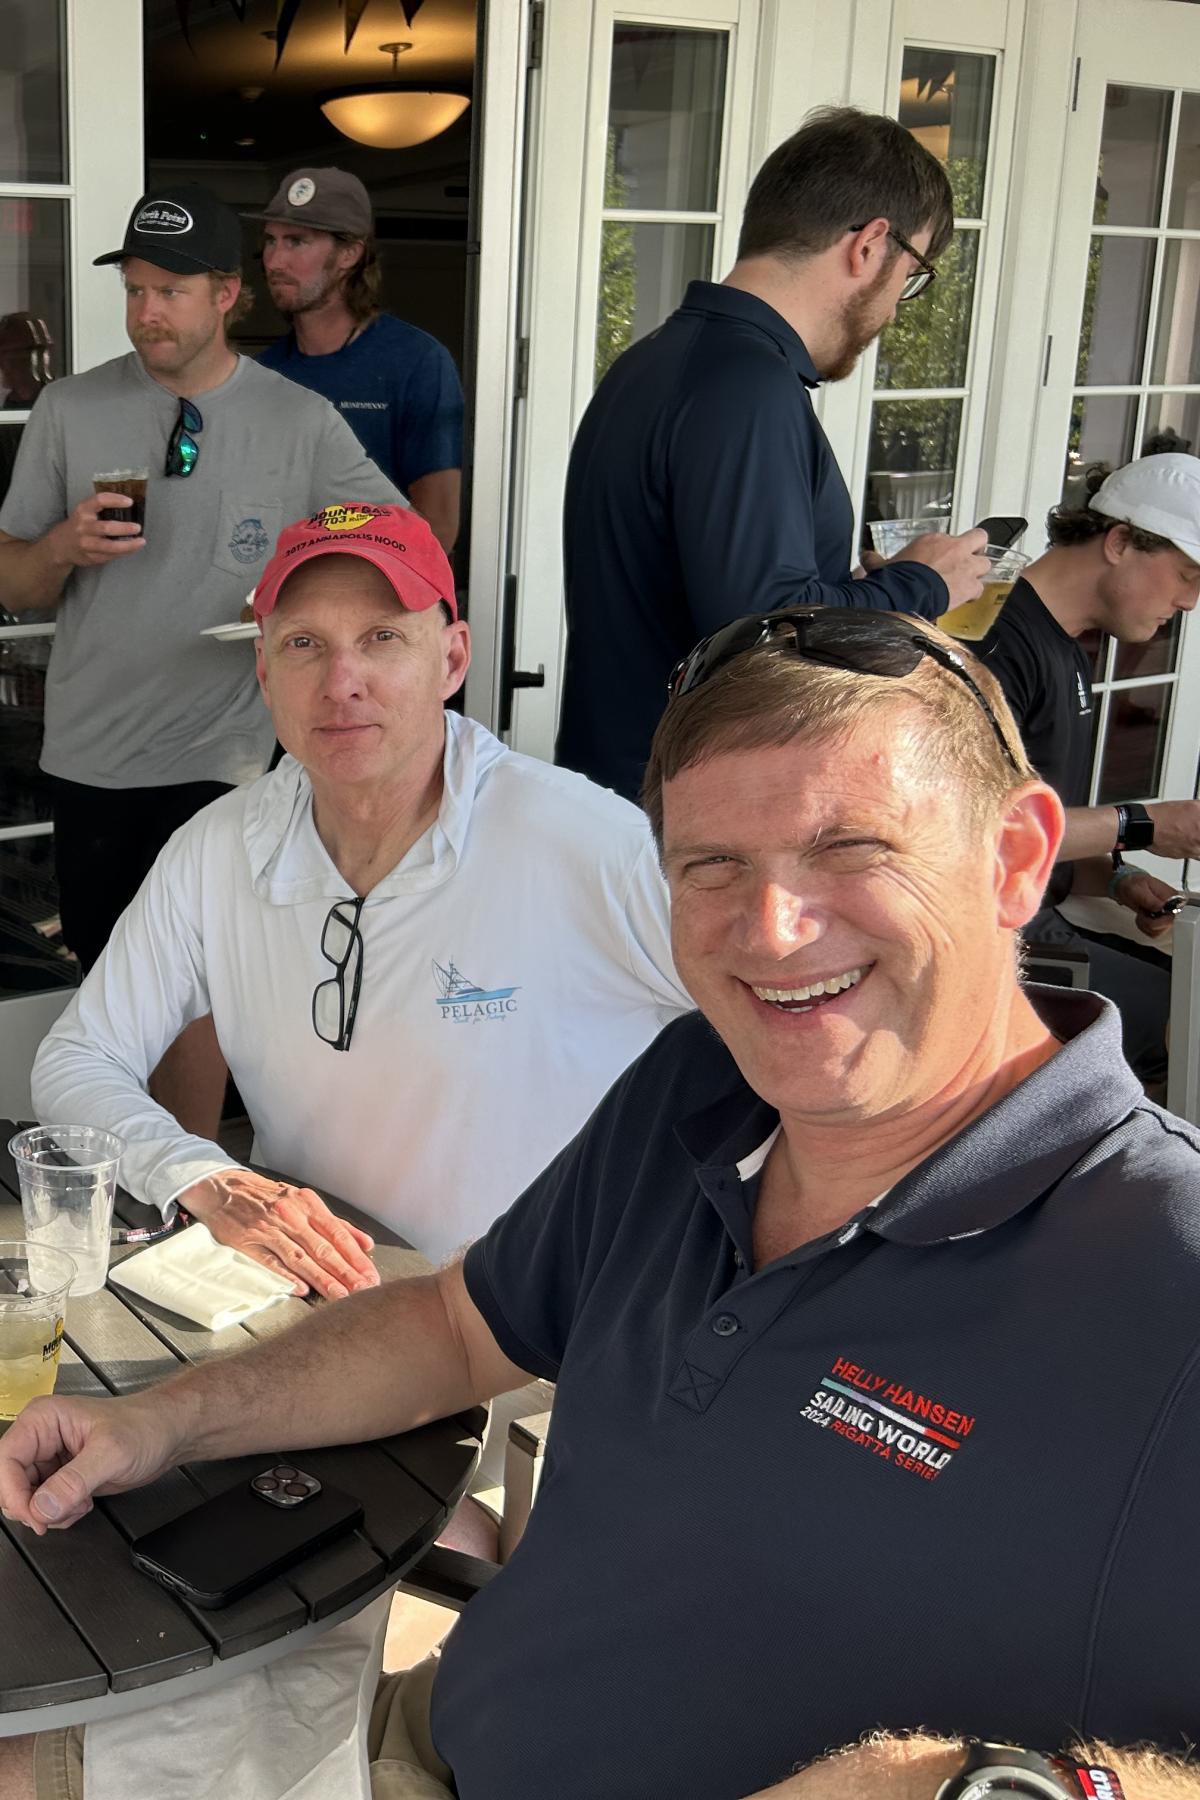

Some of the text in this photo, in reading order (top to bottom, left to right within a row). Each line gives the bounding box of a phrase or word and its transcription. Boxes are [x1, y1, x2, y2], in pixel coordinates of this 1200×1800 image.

[318, 516, 346, 527] 1703
[308, 533, 373, 548] ANNAPOLIS
[374, 535, 408, 553] NOOD
[441, 999, 518, 1019] PELAGIC
[831, 1356, 975, 1437] HELLY HANSEN
[799, 1406, 831, 1428] 2024
[831, 1420, 891, 1460] REGATTA
[810, 1391, 952, 1470] SAILING WORLD
